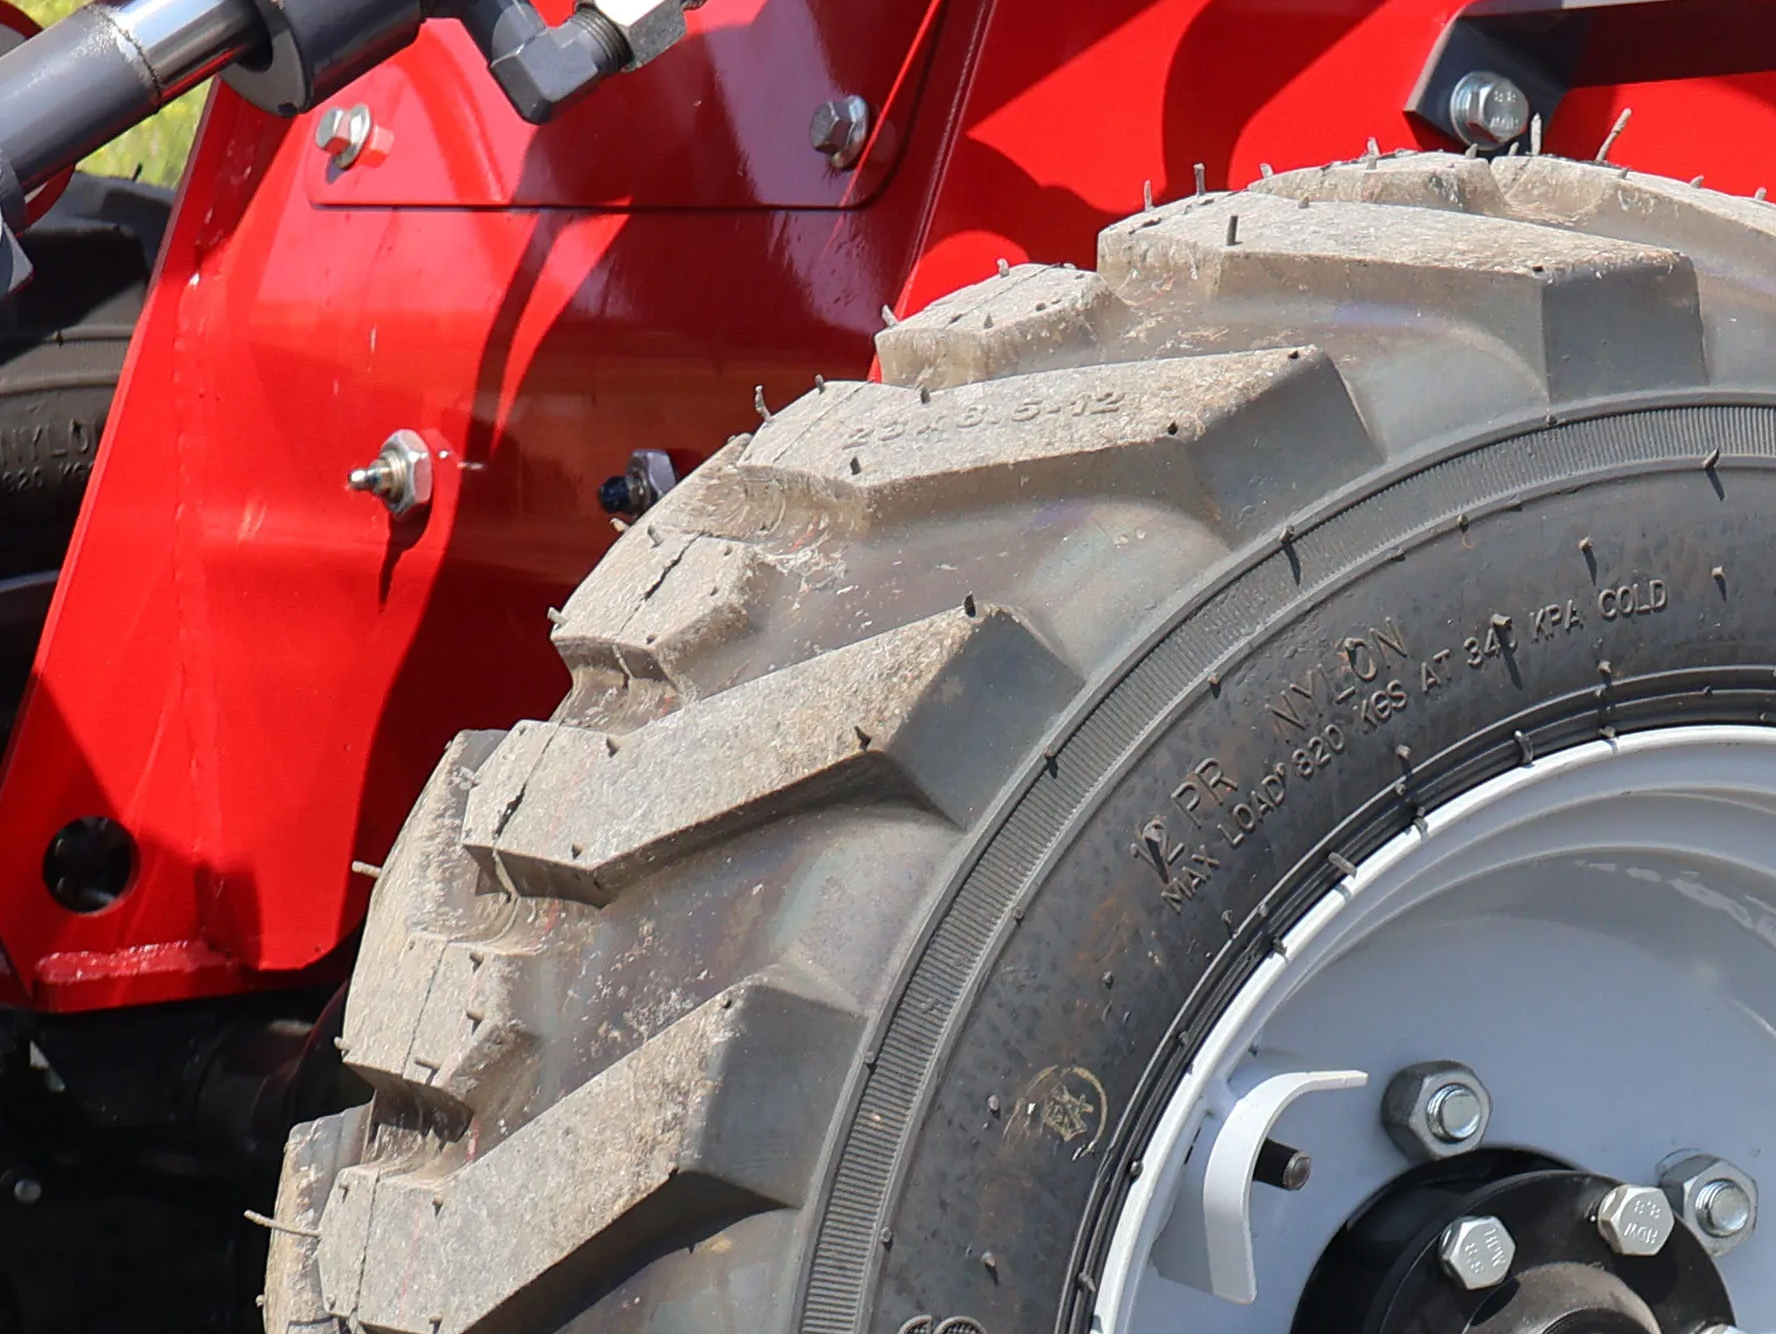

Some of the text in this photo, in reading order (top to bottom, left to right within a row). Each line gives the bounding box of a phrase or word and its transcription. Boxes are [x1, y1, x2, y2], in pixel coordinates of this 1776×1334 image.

[1159, 844, 1223, 916] MAX
[1291, 721, 1346, 784] 820
[1354, 679, 1409, 738] KGS
[1419, 647, 1456, 696] AT
[1531, 598, 1586, 646] KPA
[1595, 577, 1670, 622] COLD
[1169, 754, 1241, 823] PR
[1263, 615, 1410, 736] NYLON
